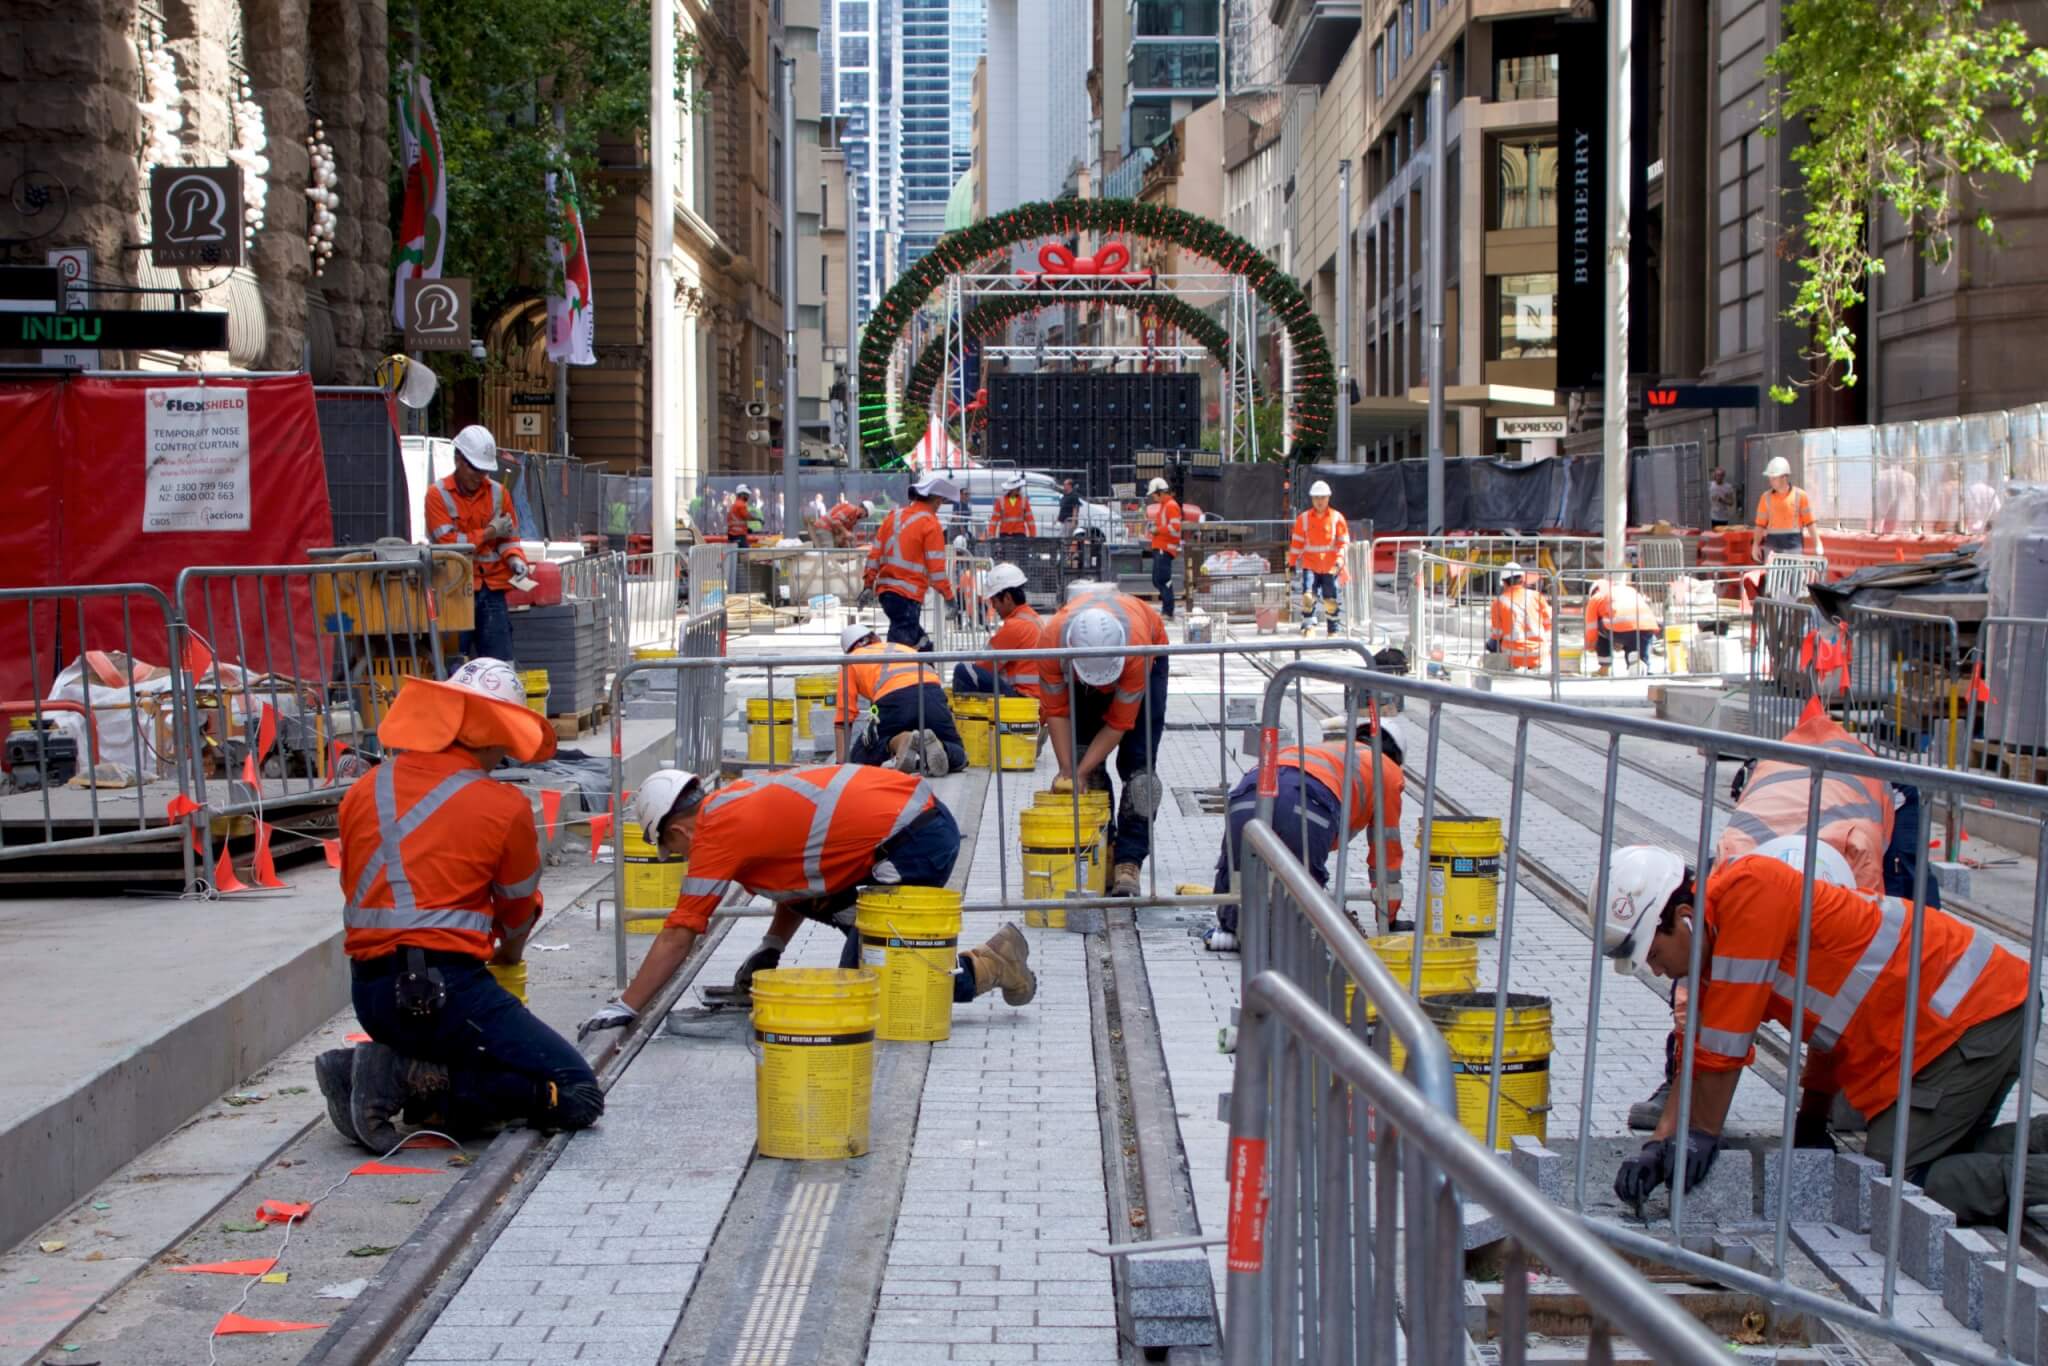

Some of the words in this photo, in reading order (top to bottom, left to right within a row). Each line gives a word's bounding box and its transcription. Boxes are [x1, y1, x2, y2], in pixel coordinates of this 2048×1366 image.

[1574, 128, 1589, 283] BURBERRY
[22, 316, 101, 341] INDU
[212, 427, 240, 436] NOISE
[1503, 420, 1563, 434] NESPRESSO
[200, 441, 239, 450] CURTAIN
[176, 483, 197, 492] 1300
[200, 482, 216, 490] 799
[217, 481, 234, 490] 969
[174, 492, 197, 501] 0800
[199, 492, 215, 500] 002
[217, 491, 234, 500] 663
[209, 511, 244, 520] acciona
